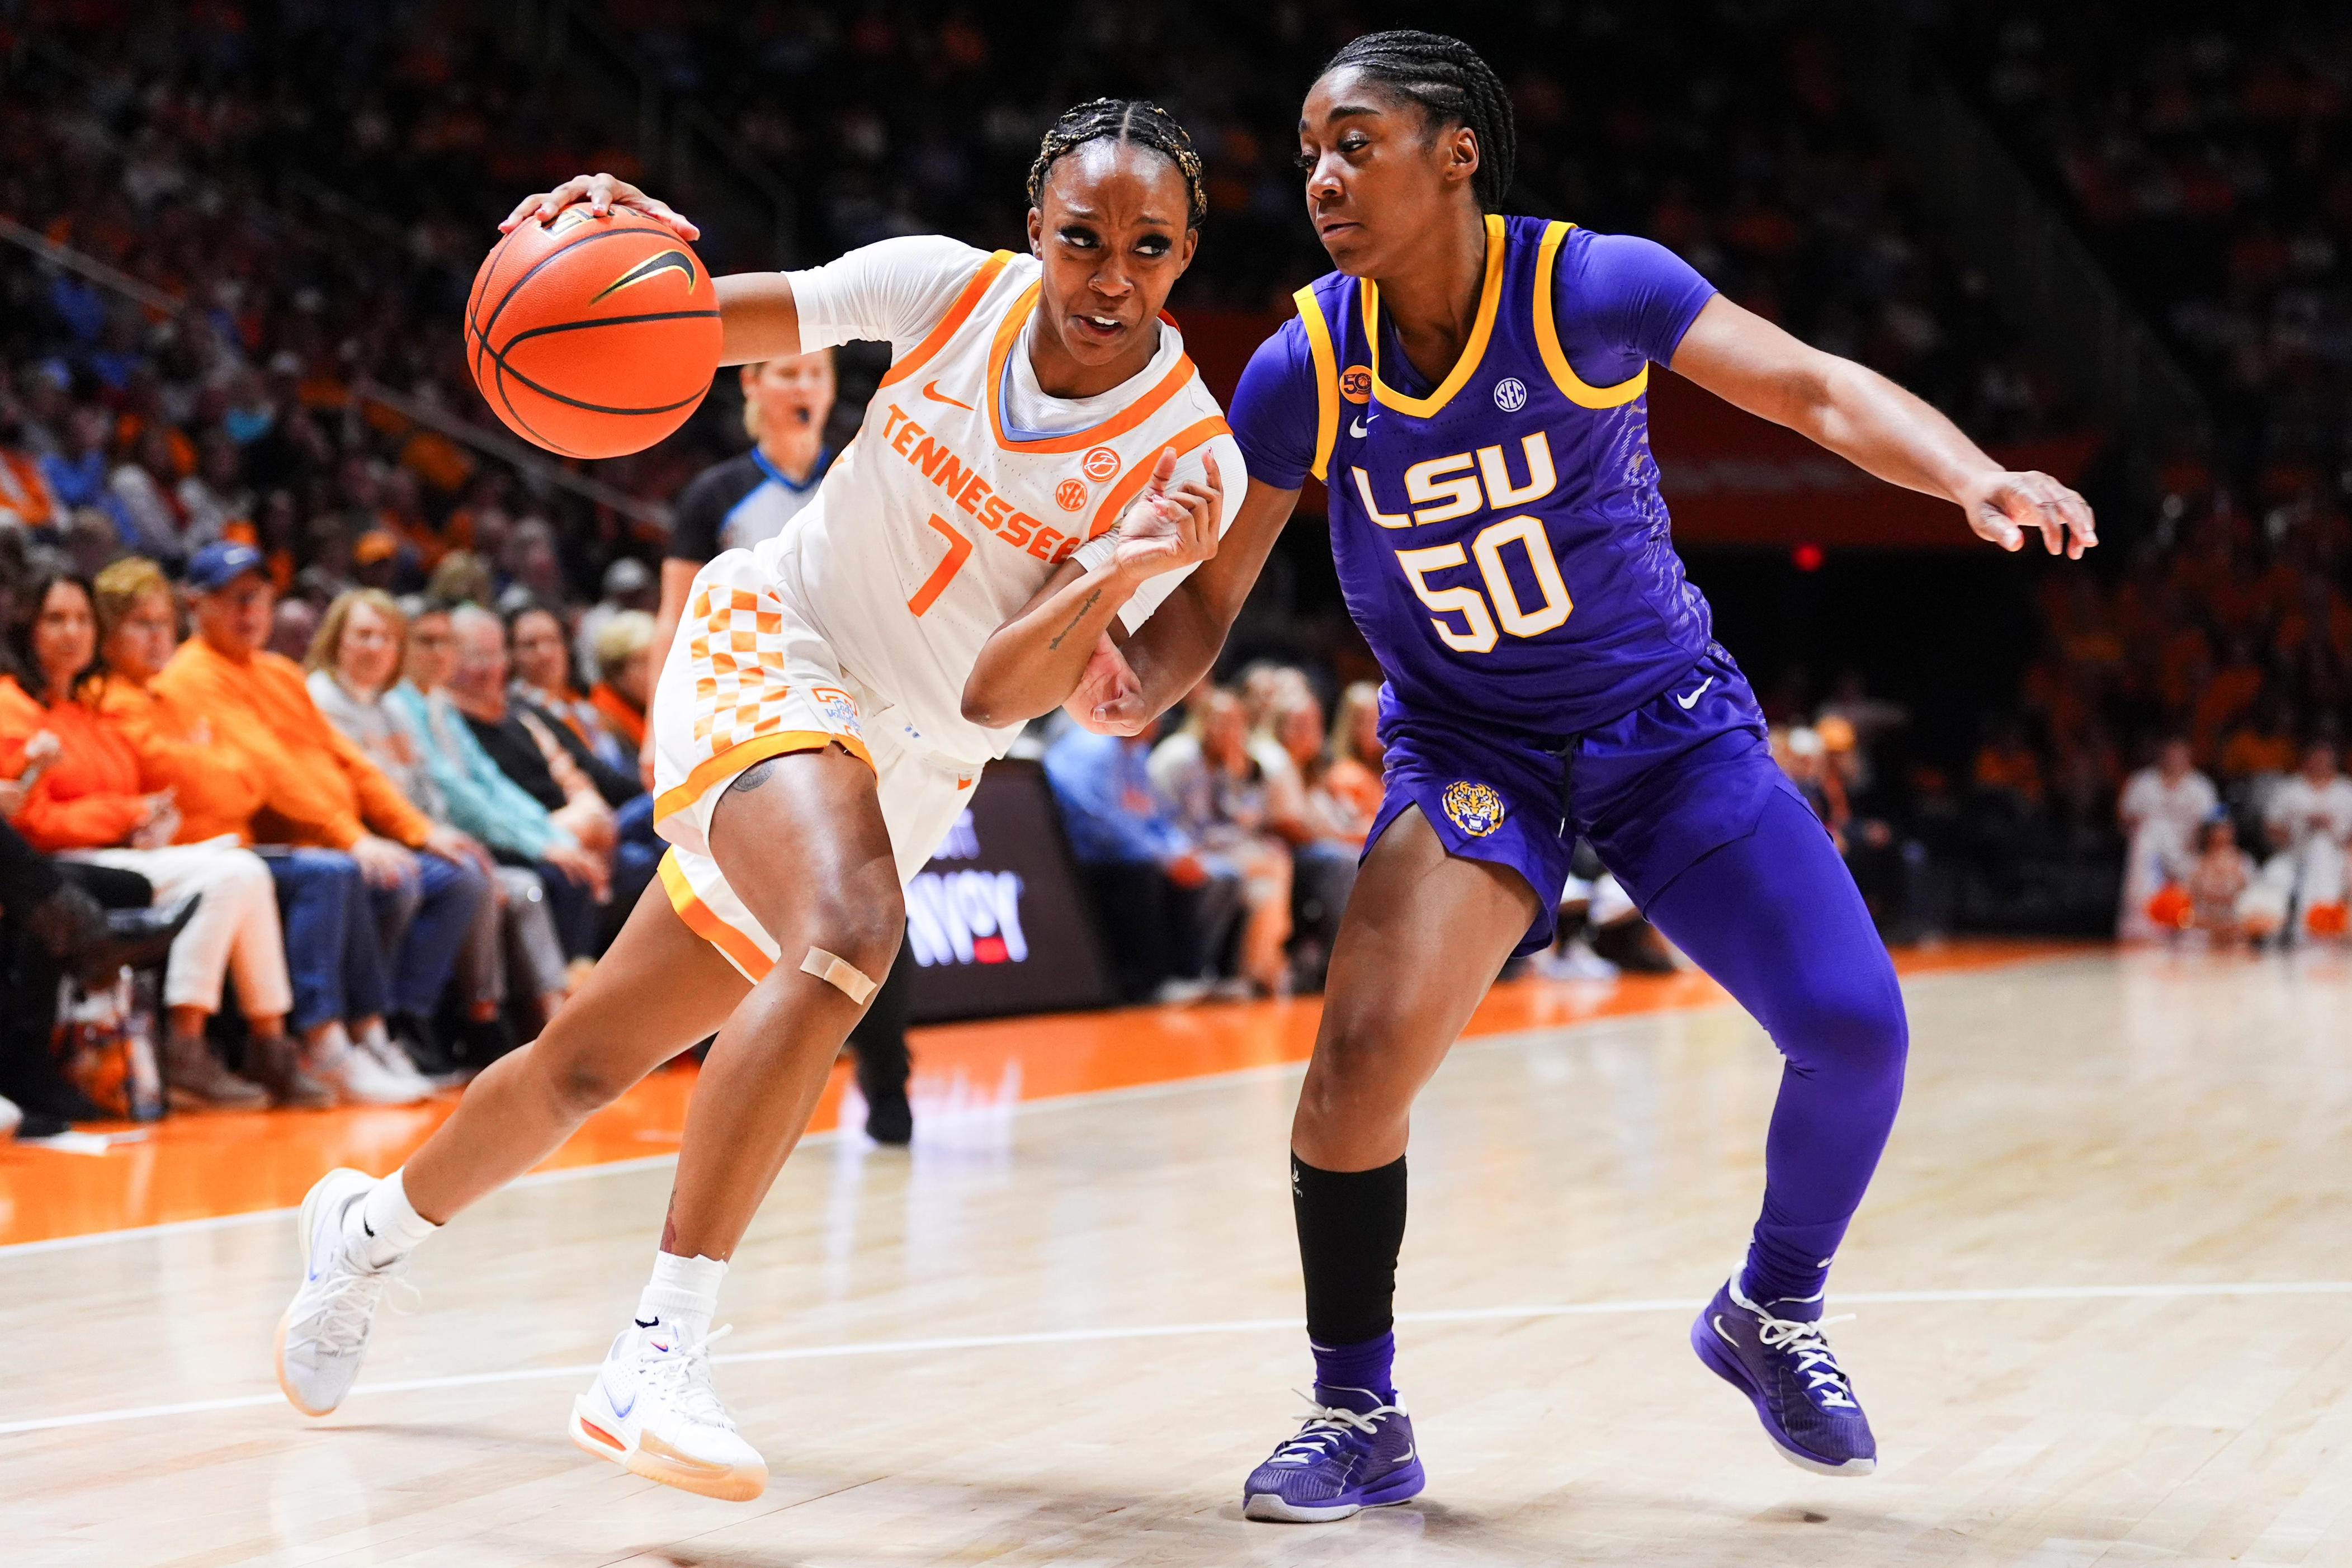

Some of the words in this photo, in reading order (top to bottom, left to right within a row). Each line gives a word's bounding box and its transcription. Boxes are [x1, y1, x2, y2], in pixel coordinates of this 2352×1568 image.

[1497, 381, 1524, 409] SEC
[1058, 481, 1085, 509] SEC
[1351, 431, 1557, 529] LSU
[908, 513, 973, 618] 7
[1395, 514, 1574, 653] 50
